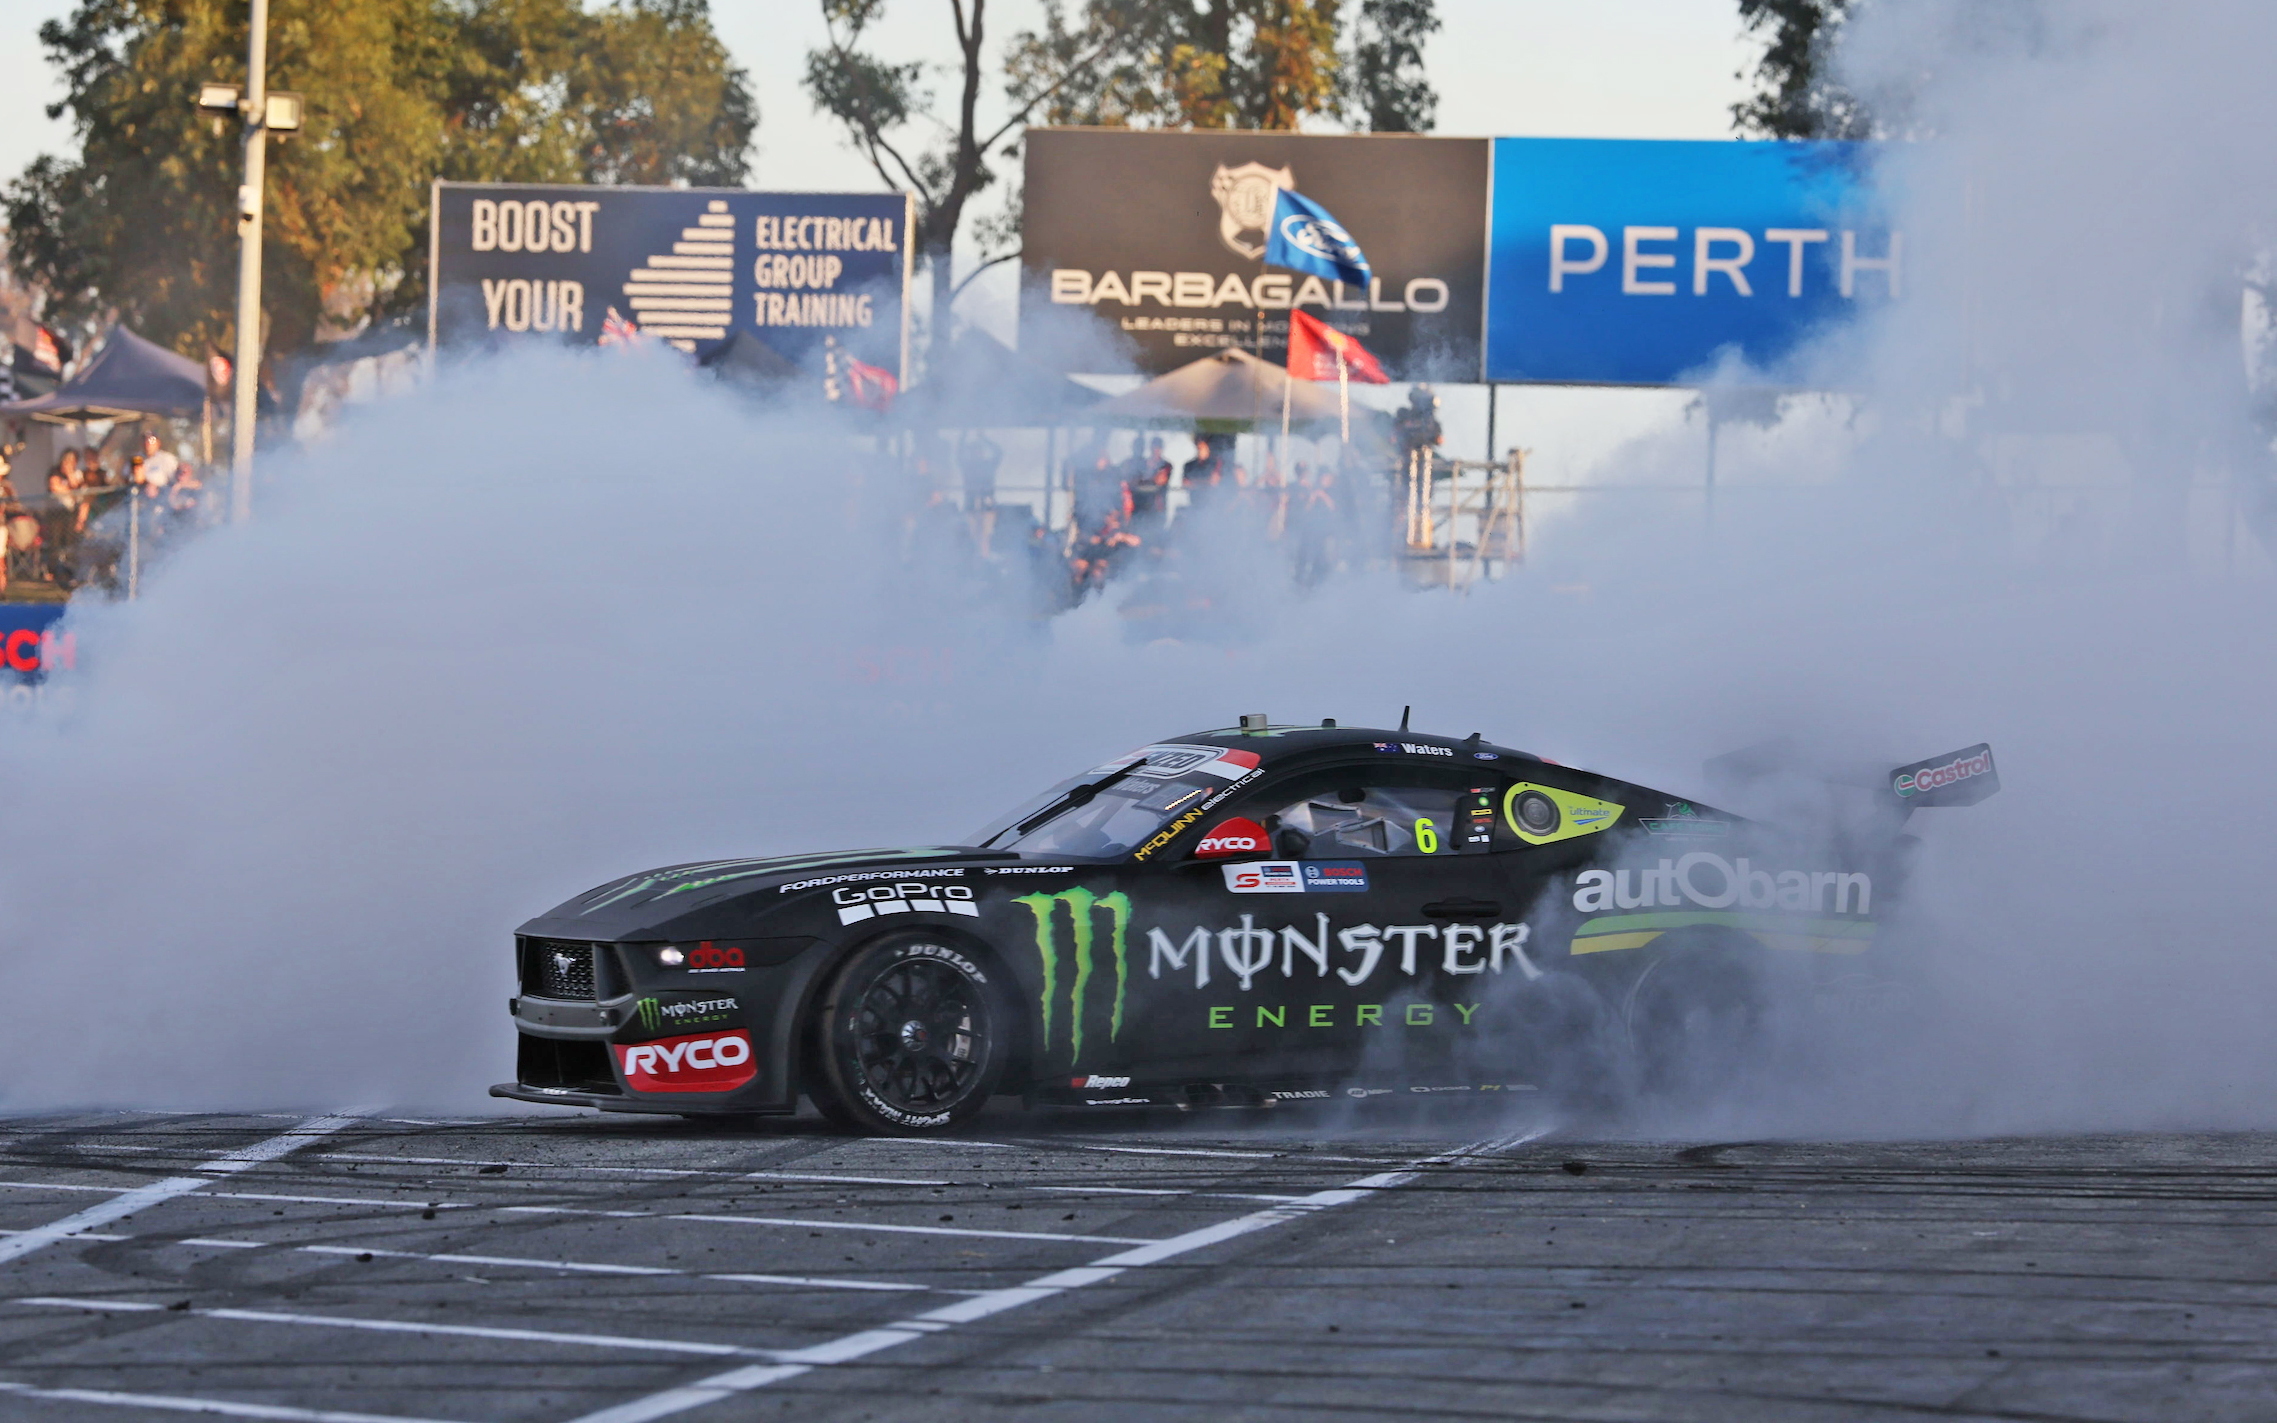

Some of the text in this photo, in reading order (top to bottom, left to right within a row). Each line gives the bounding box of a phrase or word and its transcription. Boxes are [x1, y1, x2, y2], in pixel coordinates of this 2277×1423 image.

[471, 200, 599, 253] BOOST
[755, 215, 897, 252] ELECTRICAL
[754, 255, 842, 289] GROUP
[1549, 224, 1902, 298] PERTH
[482, 279, 584, 333] YOUR
[1051, 268, 1449, 313] BARBAGALLO
[753, 293, 872, 327] TRAINING
[1121, 315, 1224, 333] LEADERS
[1173, 332, 1288, 348] EXCELLEN
[0, 629, 77, 672] CH
[1401, 742, 1454, 757] Waters
[1914, 749, 1991, 791] Castrol
[1201, 767, 1266, 812] electrical
[1194, 836, 1257, 853] RYCO
[1415, 817, 1437, 854] 6
[778, 868, 966, 894] FORDPERFORMANCE
[998, 866, 1075, 875] DUNLOP
[1322, 868, 1363, 877] BOSCH
[831, 882, 974, 905] GoPro
[688, 941, 746, 968] dba
[908, 943, 988, 984] DUNLOP
[1208, 1003, 1482, 1029] ENERGY
[624, 1036, 751, 1077] RYCO
[1084, 1074, 1132, 1089] Repco
[1271, 1090, 1331, 1099] TRADIE
